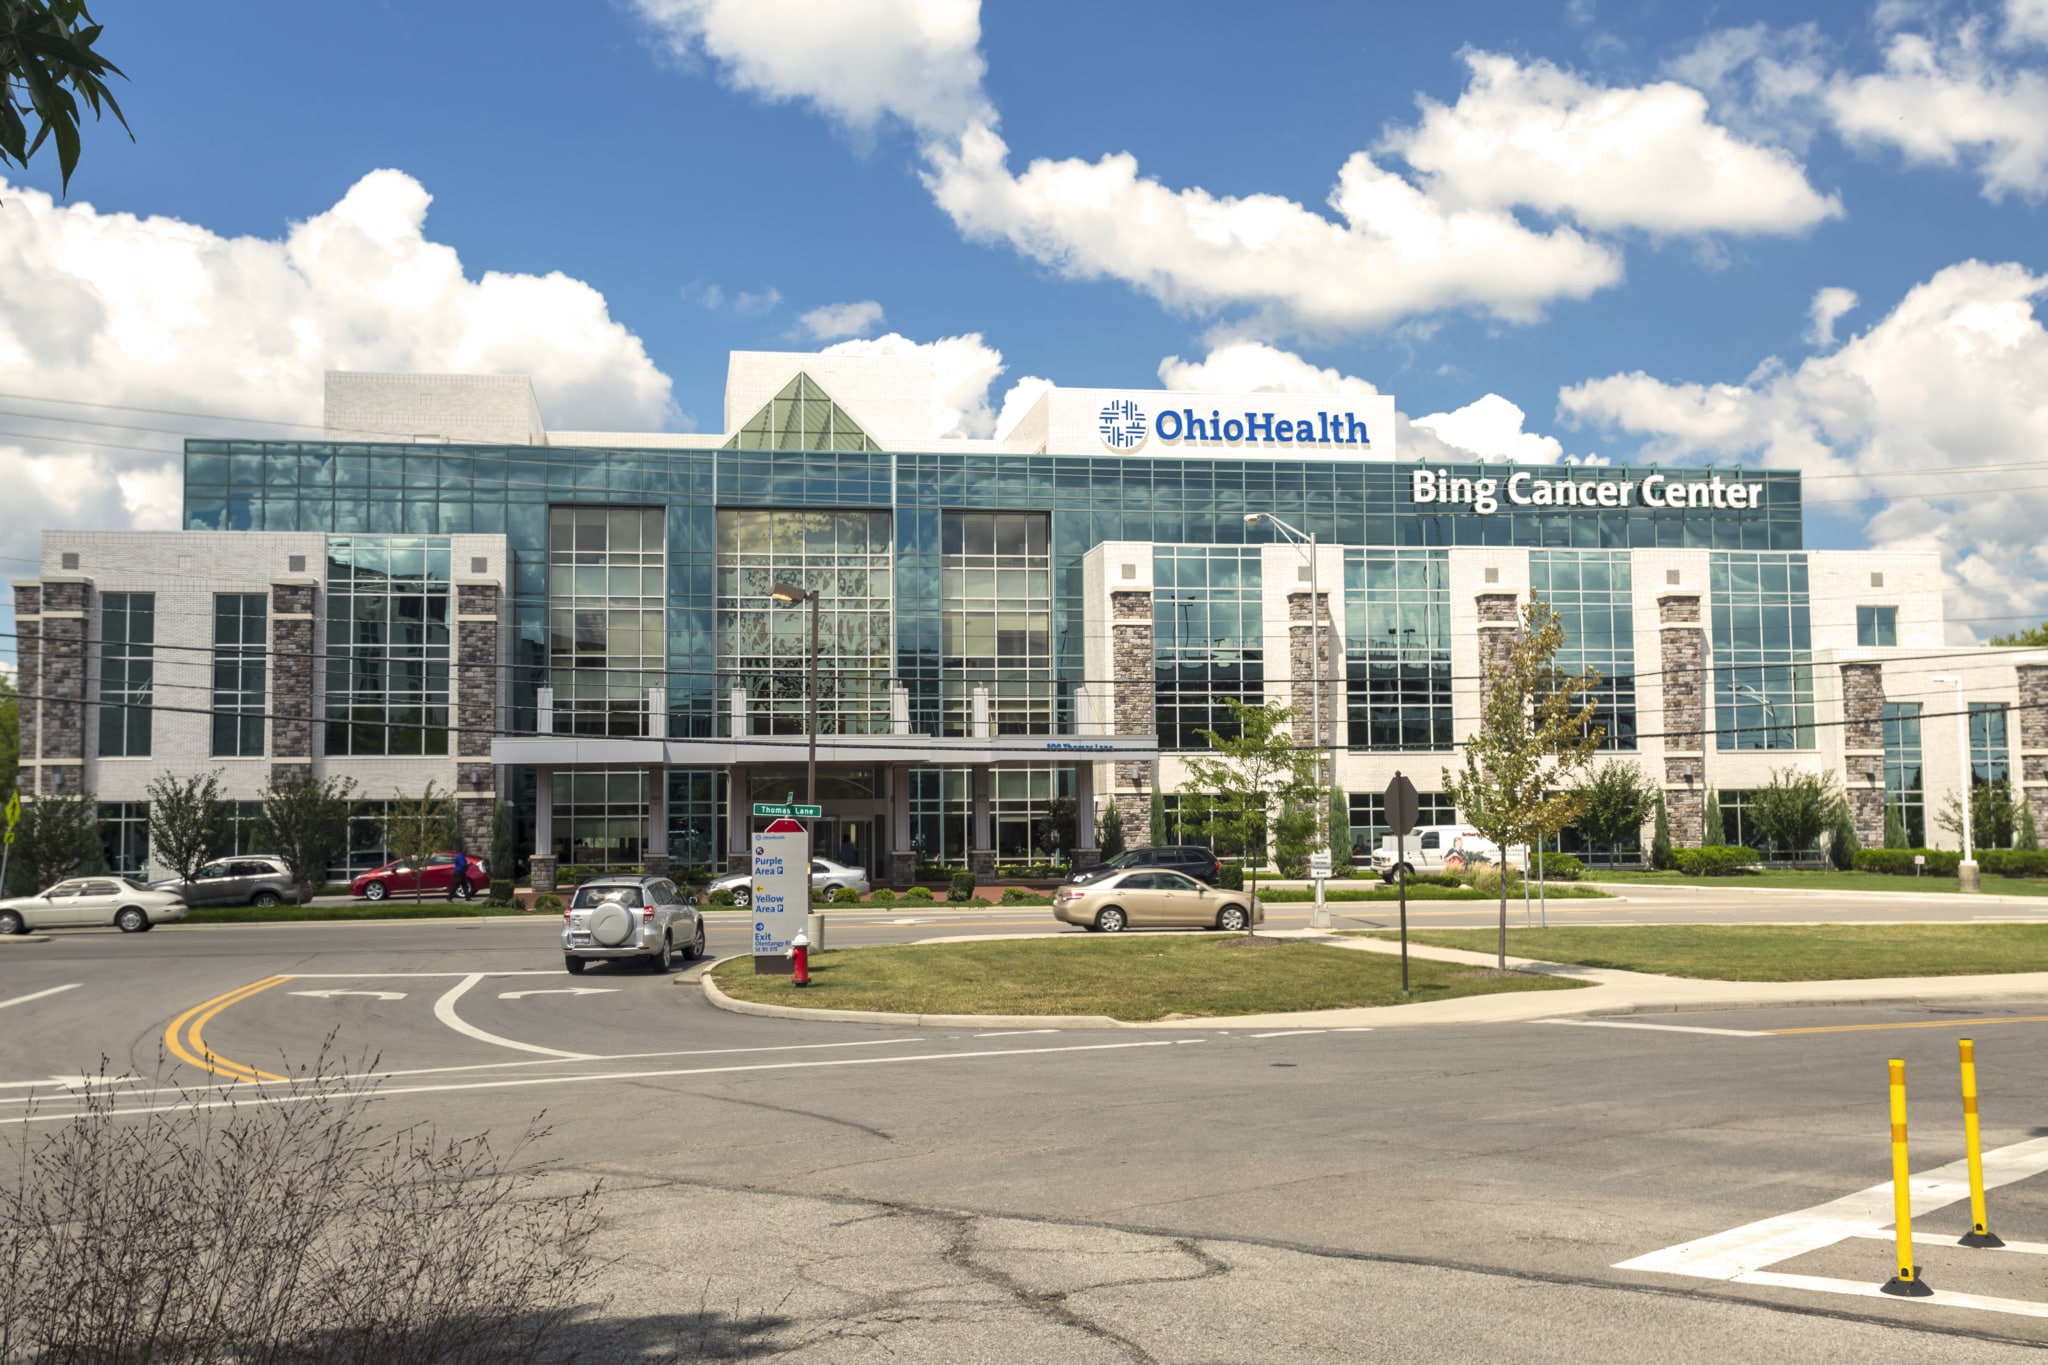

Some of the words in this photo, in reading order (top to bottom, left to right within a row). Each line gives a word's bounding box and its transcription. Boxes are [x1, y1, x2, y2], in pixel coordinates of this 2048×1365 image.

[1155, 409, 1370, 444] OhioHealth
[1412, 468, 1498, 514] Bing
[1507, 472, 1633, 507] Cancer
[1641, 475, 1763, 509] Center
[761, 806, 791, 815] Thomas
[795, 807, 814, 815] Lane
[755, 857, 783, 867] Purple
[755, 867, 775, 875] Area
[755, 895, 784, 903] Yellow
[755, 905, 775, 913] Area
[755, 933, 771, 941] Exit
